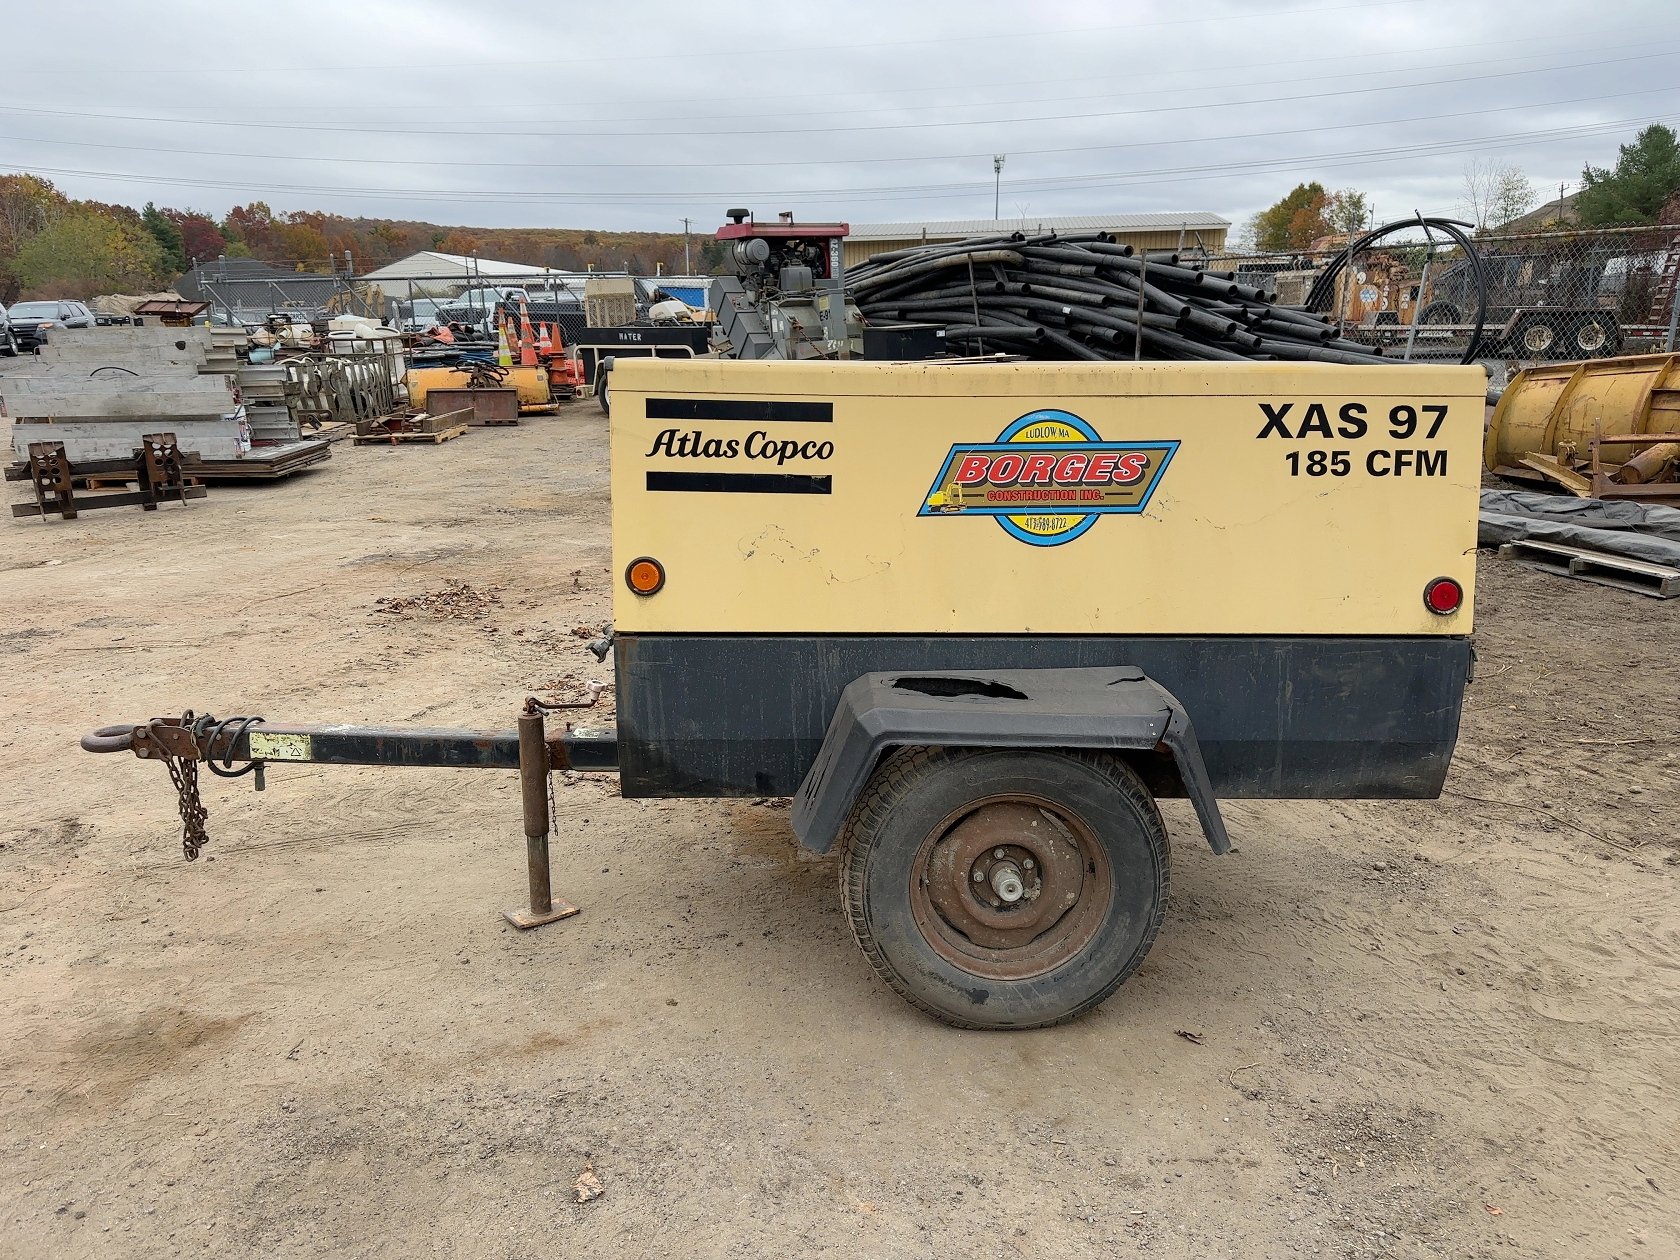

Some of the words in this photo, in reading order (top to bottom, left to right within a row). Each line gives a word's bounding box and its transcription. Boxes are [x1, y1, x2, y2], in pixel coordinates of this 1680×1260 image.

[618, 332, 642, 342] WATER
[1058, 428, 1070, 438] MA
[1256, 402, 1368, 440] XAS
[1388, 405, 1449, 440] 97
[645, 429, 740, 458] Atlas
[744, 430, 834, 465] Copco
[954, 453, 1148, 485] BORGES
[1285, 450, 1351, 477] 185
[1366, 449, 1448, 477] CFM
[987, 490, 1077, 501] CONSTRUCTION
[1080, 489, 1105, 501] INC.
